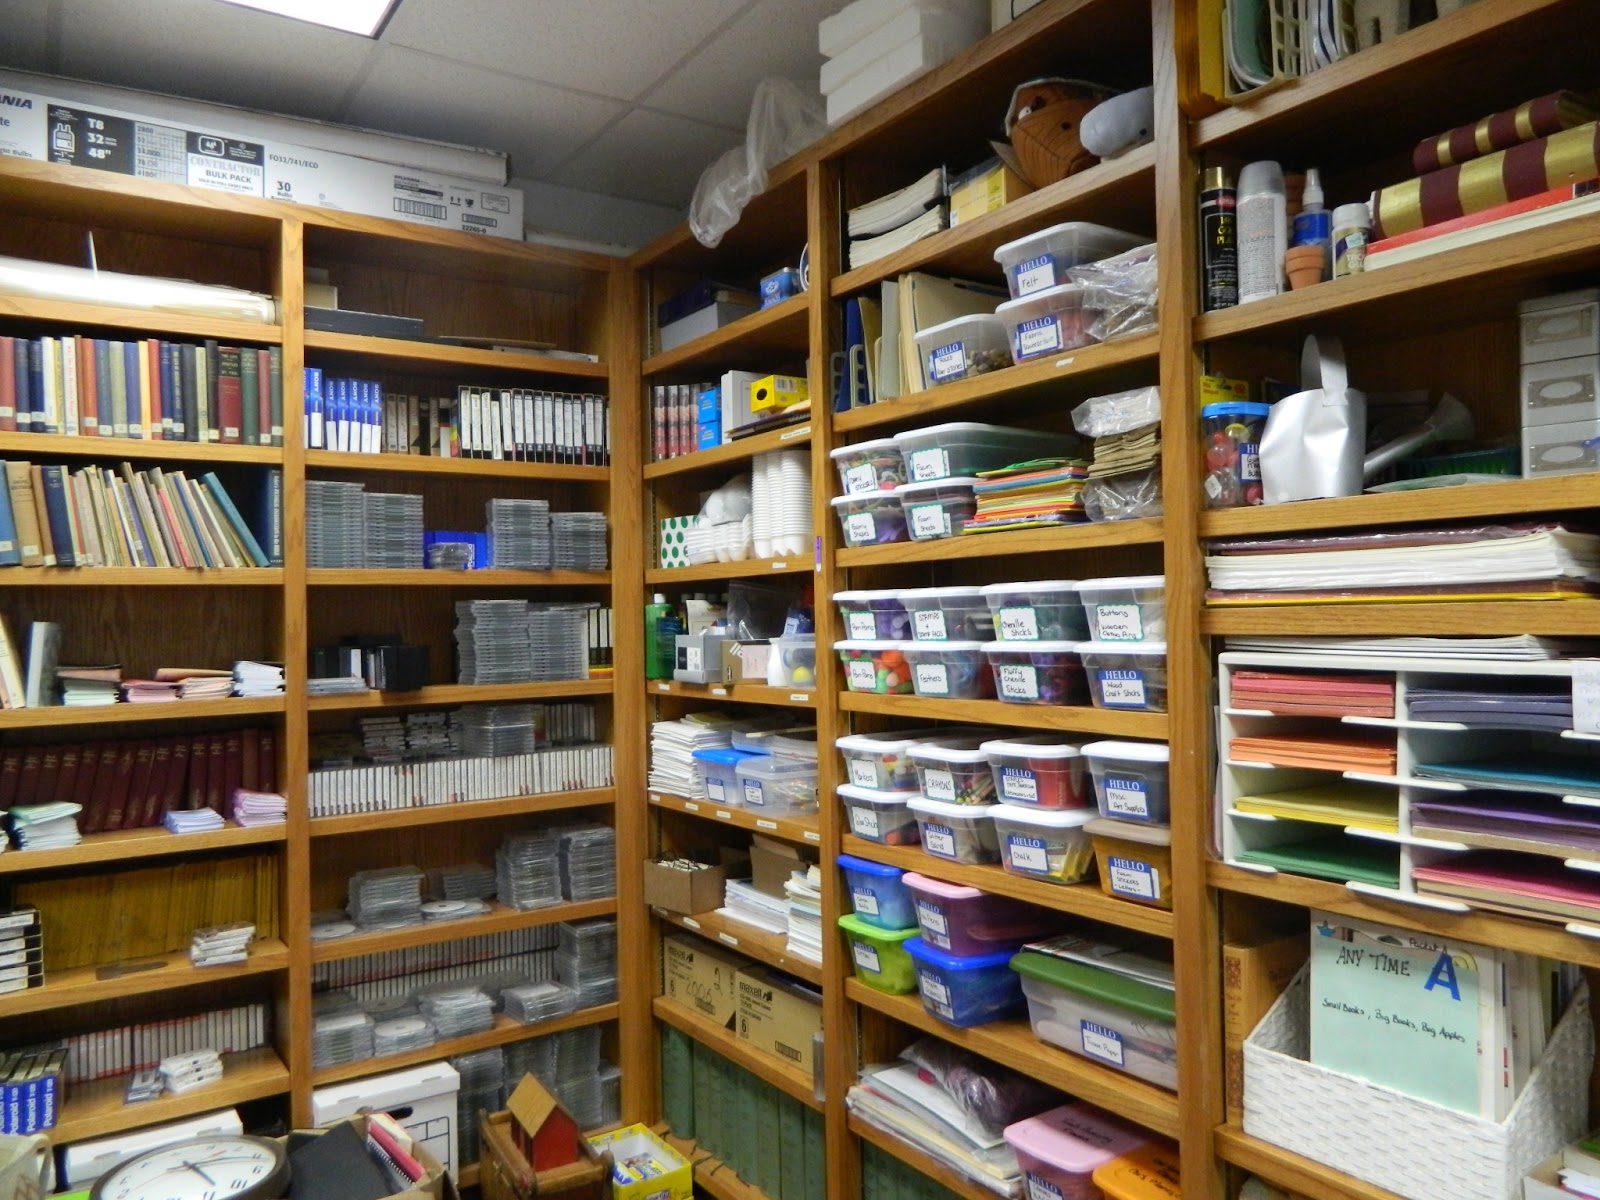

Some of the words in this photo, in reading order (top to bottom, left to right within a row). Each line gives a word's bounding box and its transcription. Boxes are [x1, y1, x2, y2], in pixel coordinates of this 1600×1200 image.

[88, 118, 104, 130] T8
[88, 132, 104, 144] 32
[190, 155, 261, 176] CONTRACTOR
[206, 170, 228, 180] BULK
[230, 174, 252, 184] PACK
[277, 181, 291, 192] 30
[1020, 256, 1048, 273] HELLO
[1022, 276, 1039, 288] Felt
[1023, 316, 1052, 332] HELLO
[936, 344, 958, 357] HELLO
[1100, 608, 1128, 618] Buttons
[1012, 628, 1032, 636] Sticks
[920, 674, 942, 682] Feathers
[1106, 670, 1136, 680] HELLO
[1006, 685, 1026, 694] Sticks
[1006, 768, 1032, 778] HELLO
[746, 779, 760, 788] HELLO
[928, 778, 951, 791] CRAYONS
[1110, 779, 1140, 790] HELLO
[928, 823, 950, 834] HELLO
[1013, 836, 1040, 848] HELLO
[1014, 852, 1032, 862] Chalk
[1114, 858, 1144, 872] HELLO
[854, 886, 872, 896] HELLO
[920, 900, 940, 914] HELLO
[854, 942, 874, 952] HELLO
[1408, 938, 1439, 952] Packet
[1336, 946, 1364, 967] ANY
[1369, 953, 1410, 976] TIME
[922, 969, 941, 983] HELLO
[1424, 953, 1462, 1002] A
[740, 982, 762, 998] maxell
[742, 1018, 746, 1033] 6
[1322, 998, 1341, 1010] Small
[1375, 1008, 1390, 1024] Big
[1440, 1027, 1466, 1042] Apples
[1086, 1022, 1116, 1038] HELLO
[1102, 1044, 1120, 1056] Paper
[27, 1098, 36, 1132] Polaroid
[43, 1092, 54, 1127] Polaroid
[10, 1102, 19, 1135] Polaroid
[230, 1178, 248, 1190] 10
[1030, 1174, 1058, 1193] HELLO
